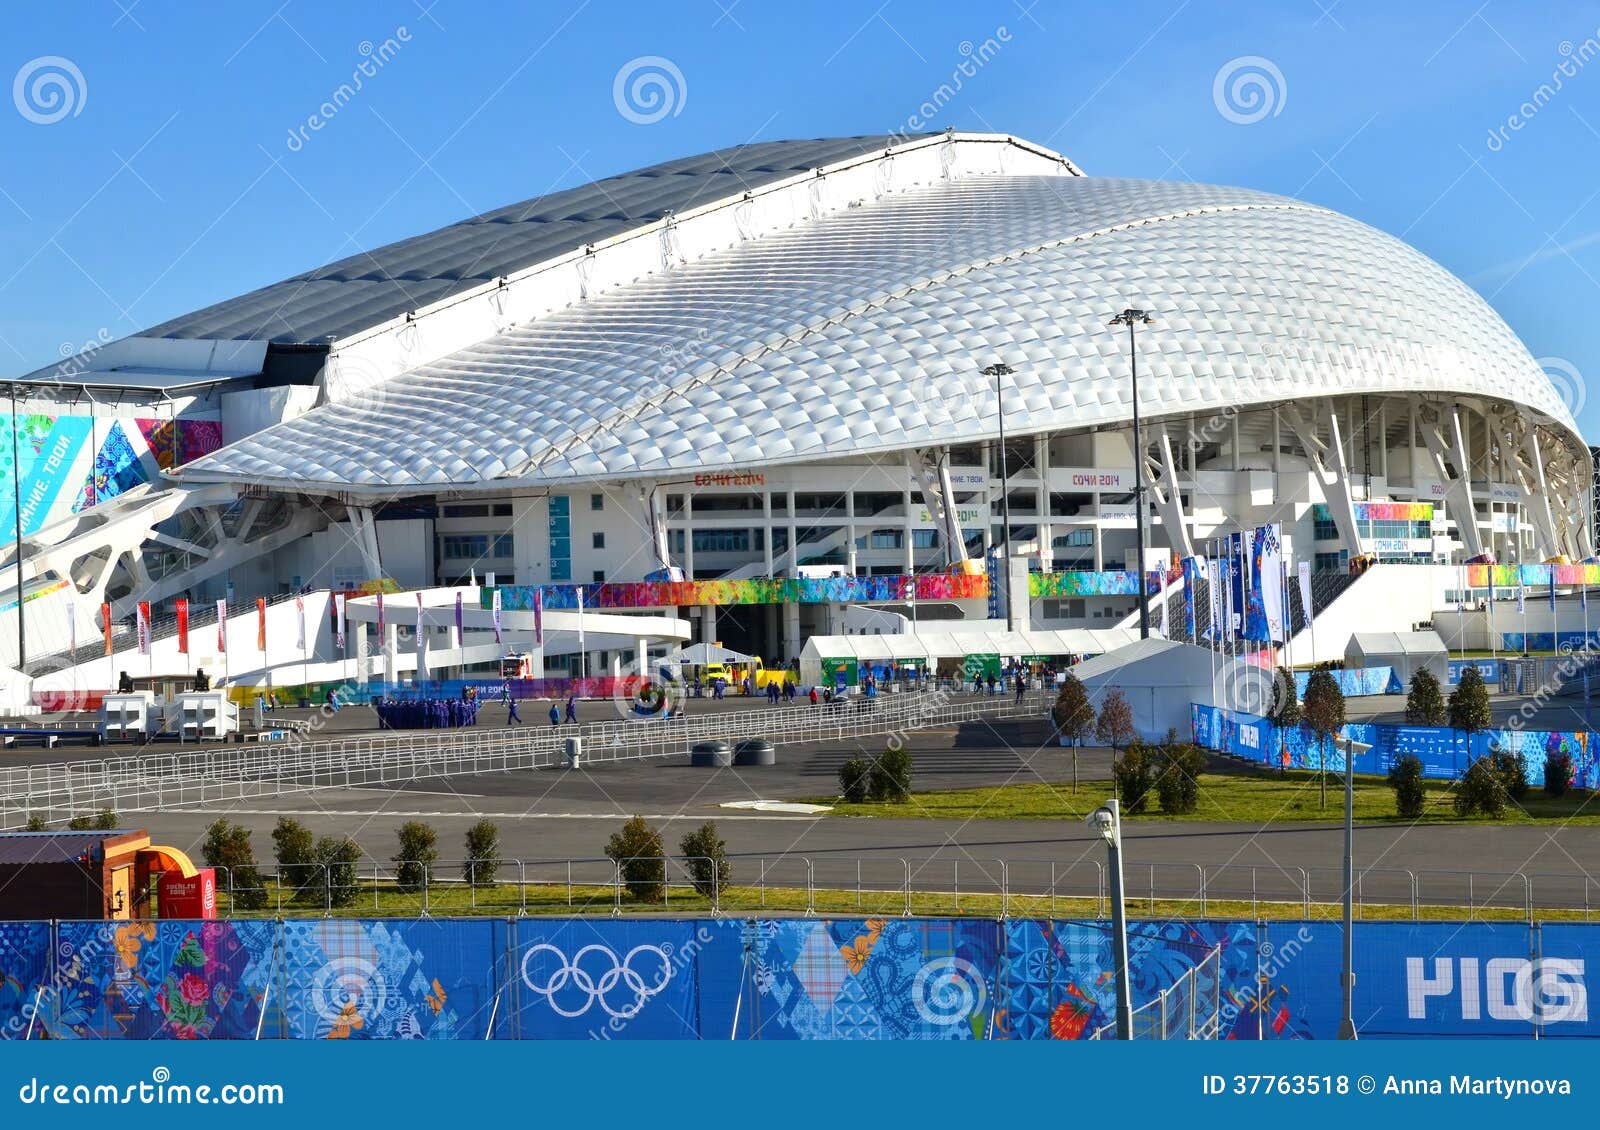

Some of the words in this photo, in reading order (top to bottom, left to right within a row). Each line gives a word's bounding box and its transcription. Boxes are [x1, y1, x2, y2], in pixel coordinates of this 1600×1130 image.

[42, 435, 73, 475] ТВОИ.
[1072, 474, 1097, 486] СОЧИ
[1099, 474, 1120, 486] 2014
